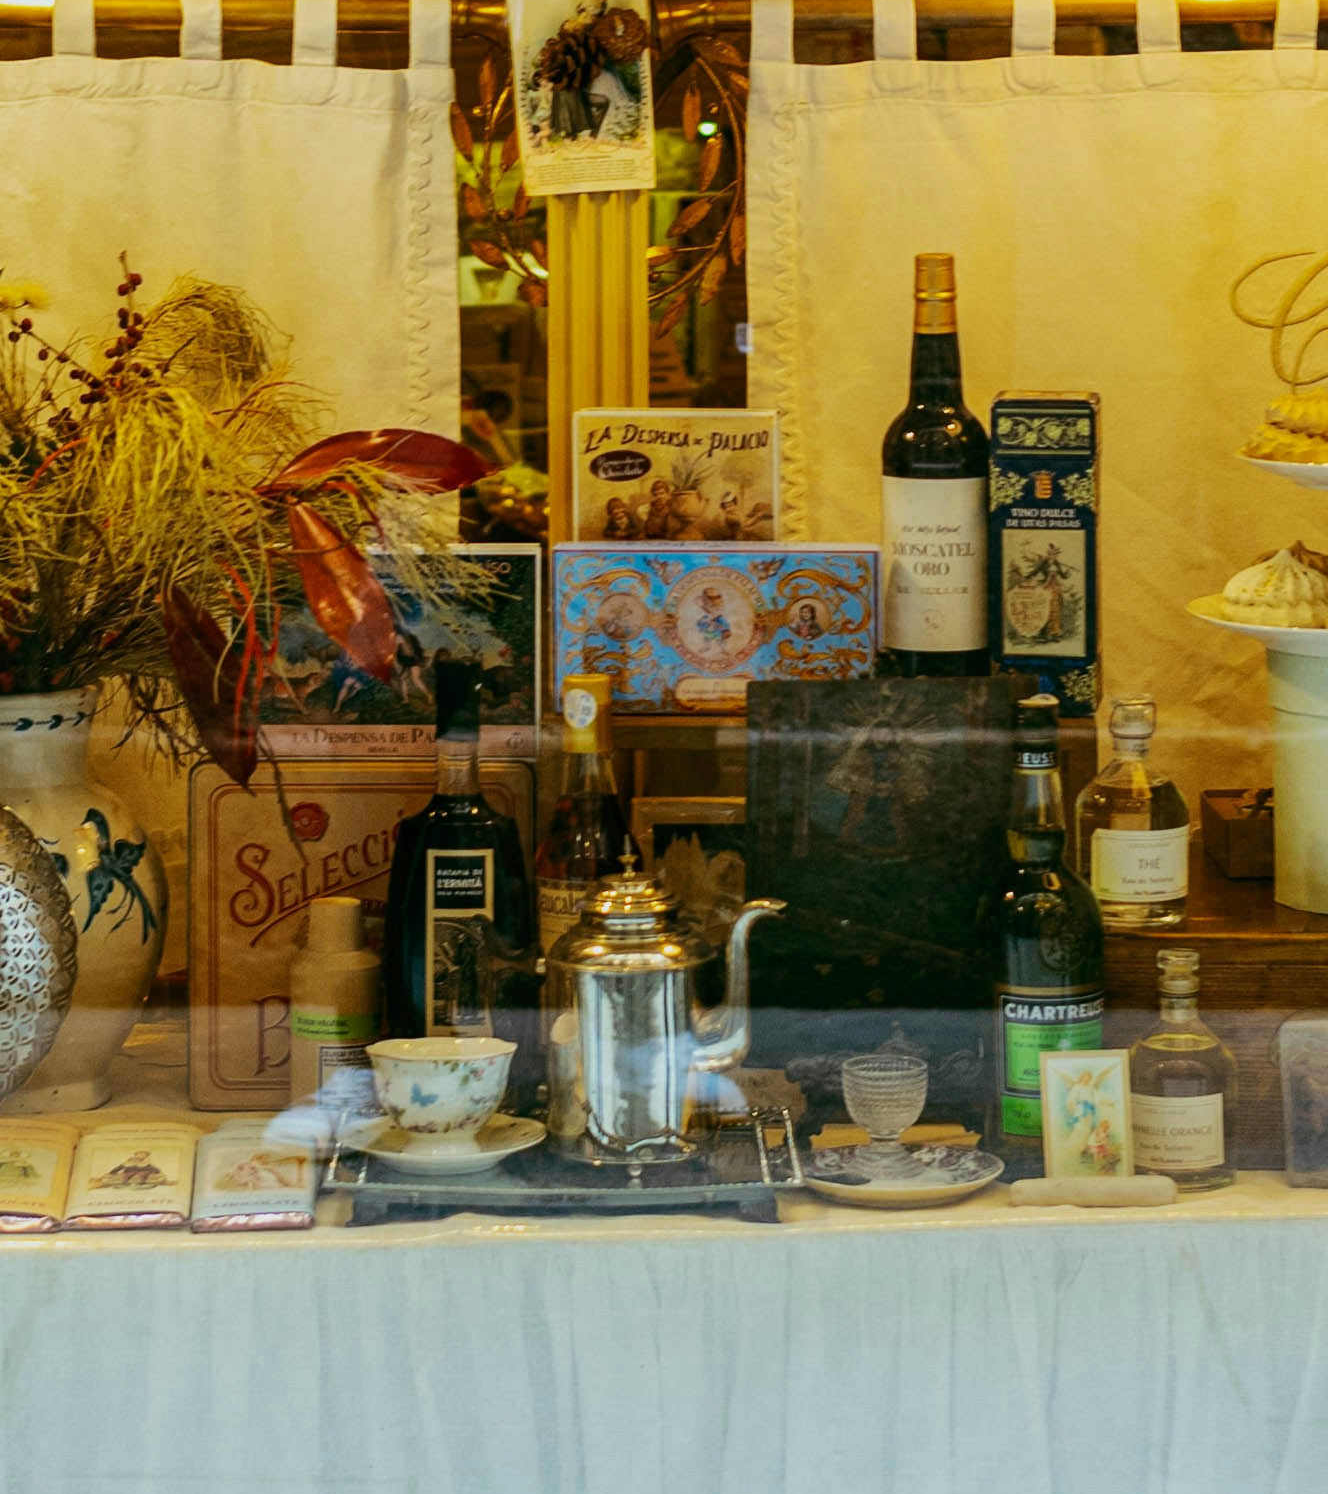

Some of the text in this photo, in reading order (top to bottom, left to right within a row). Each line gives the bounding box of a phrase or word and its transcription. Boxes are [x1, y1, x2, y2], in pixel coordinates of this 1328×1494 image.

[583, 424, 612, 454] LA
[708, 430, 769, 458] PALACIO
[891, 542, 976, 557] MOSCATEL
[913, 562, 950, 576] ORO
[313, 727, 386, 743] DESPENSA
[389, 732, 409, 743] DE
